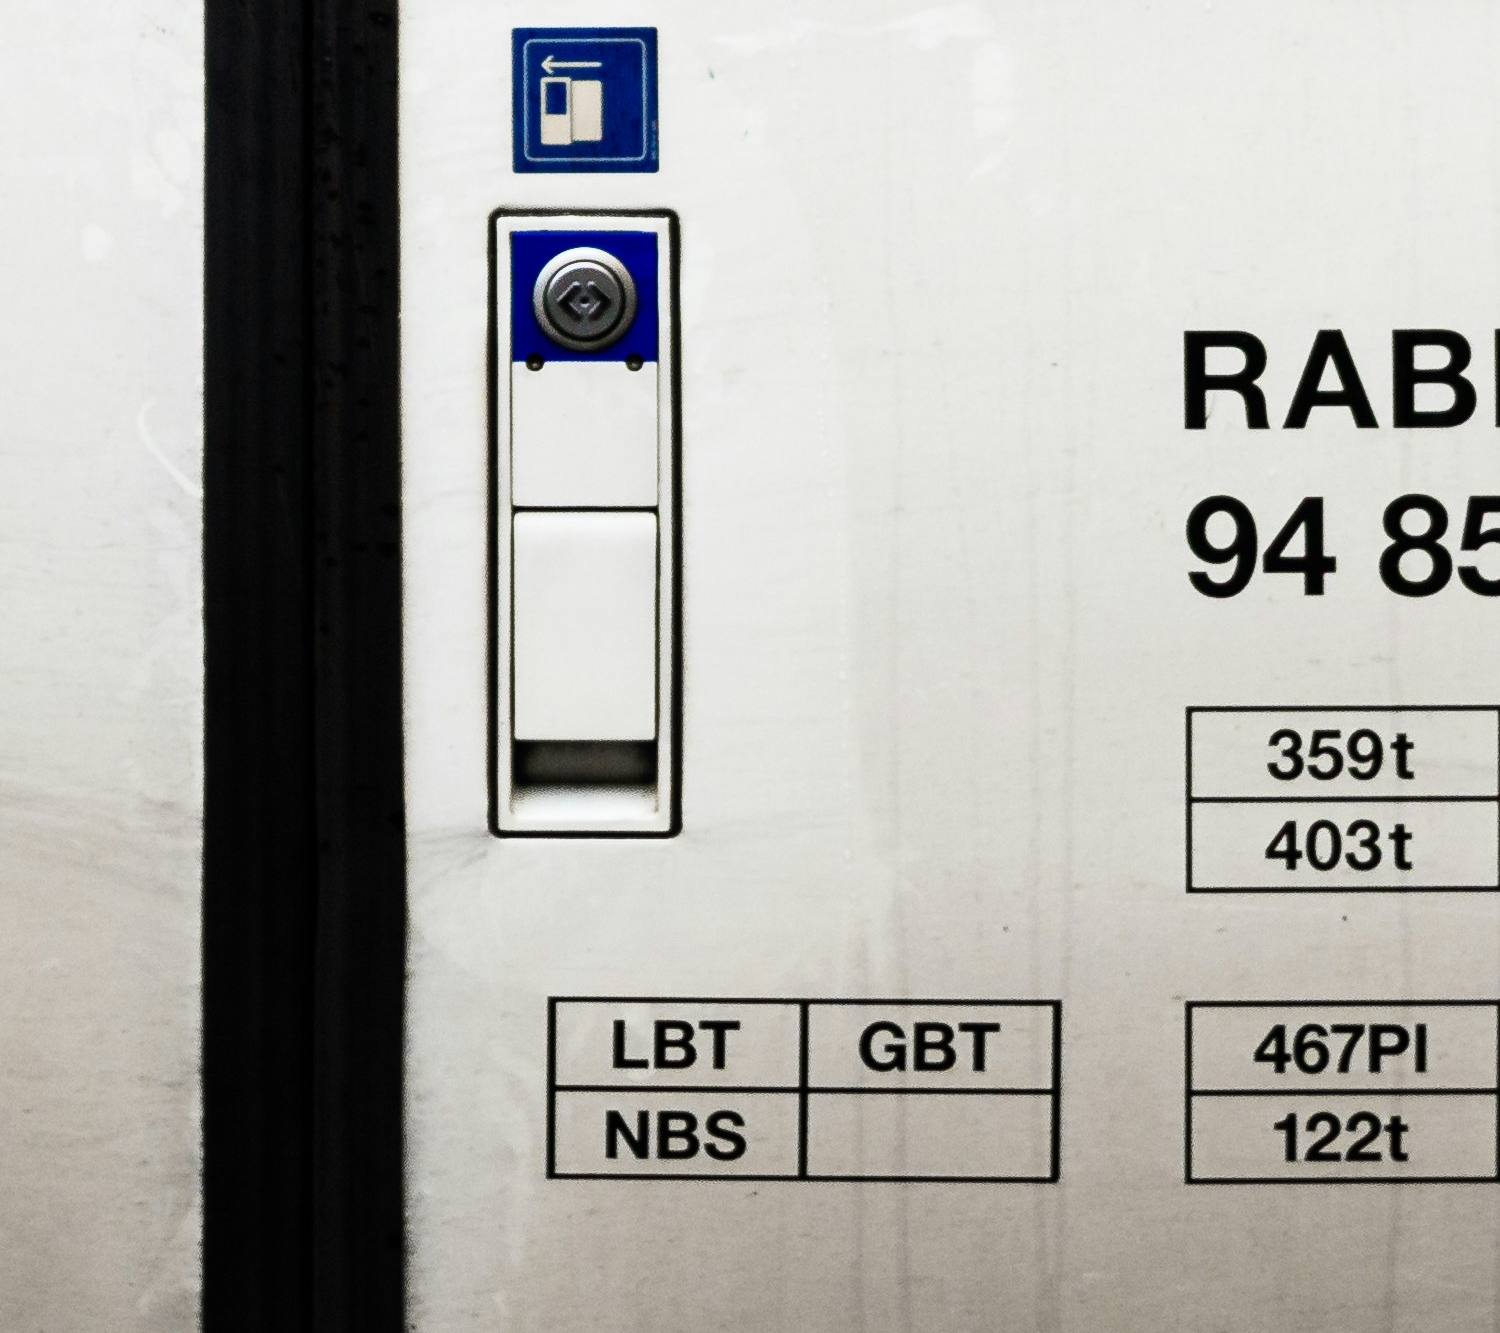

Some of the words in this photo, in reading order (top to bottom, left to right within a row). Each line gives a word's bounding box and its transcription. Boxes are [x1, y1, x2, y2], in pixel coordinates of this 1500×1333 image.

[1186, 496, 1336, 598] 94
[1268, 729, 1414, 780] 359t
[1266, 820, 1412, 871] 403t
[613, 1020, 740, 1069] LBT
[859, 1021, 1000, 1072] GBT
[606, 1110, 746, 1161] NBS
[1274, 1111, 1408, 1162] 122t
